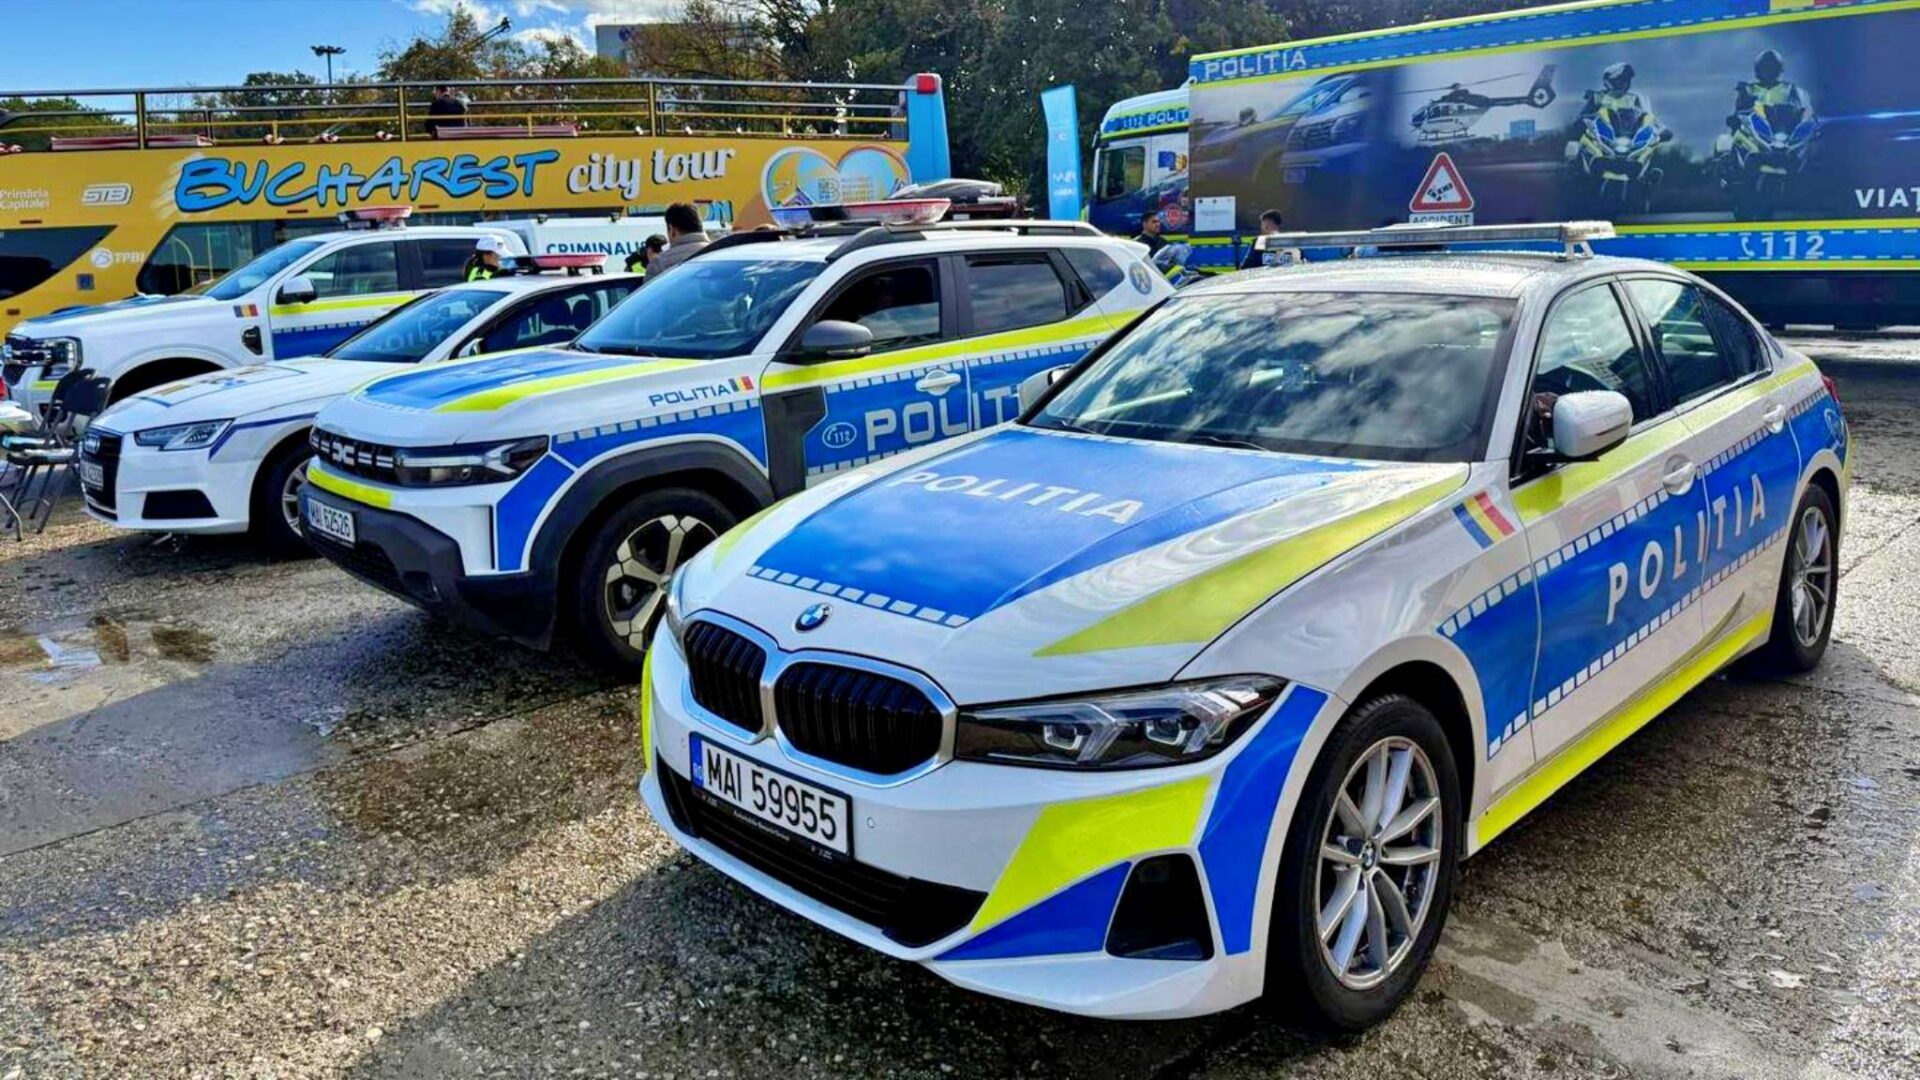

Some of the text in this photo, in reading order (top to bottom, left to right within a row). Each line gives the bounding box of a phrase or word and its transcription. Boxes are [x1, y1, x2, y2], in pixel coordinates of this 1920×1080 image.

[1204, 52, 1307, 79] POLITIA
[174, 148, 736, 212] BUCHAREST city tour
[83, 186, 129, 203] STB
[1412, 214, 1471, 225] ACCIDENT
[1761, 235, 1824, 257] 112
[648, 384, 731, 407] POLITIA
[834, 430, 850, 444] 112
[885, 471, 1144, 525] POLITIA
[309, 500, 324, 527] MAI
[1606, 474, 1766, 625] POLITIA
[707, 748, 742, 802] MAI
[751, 769, 837, 841] 59955
